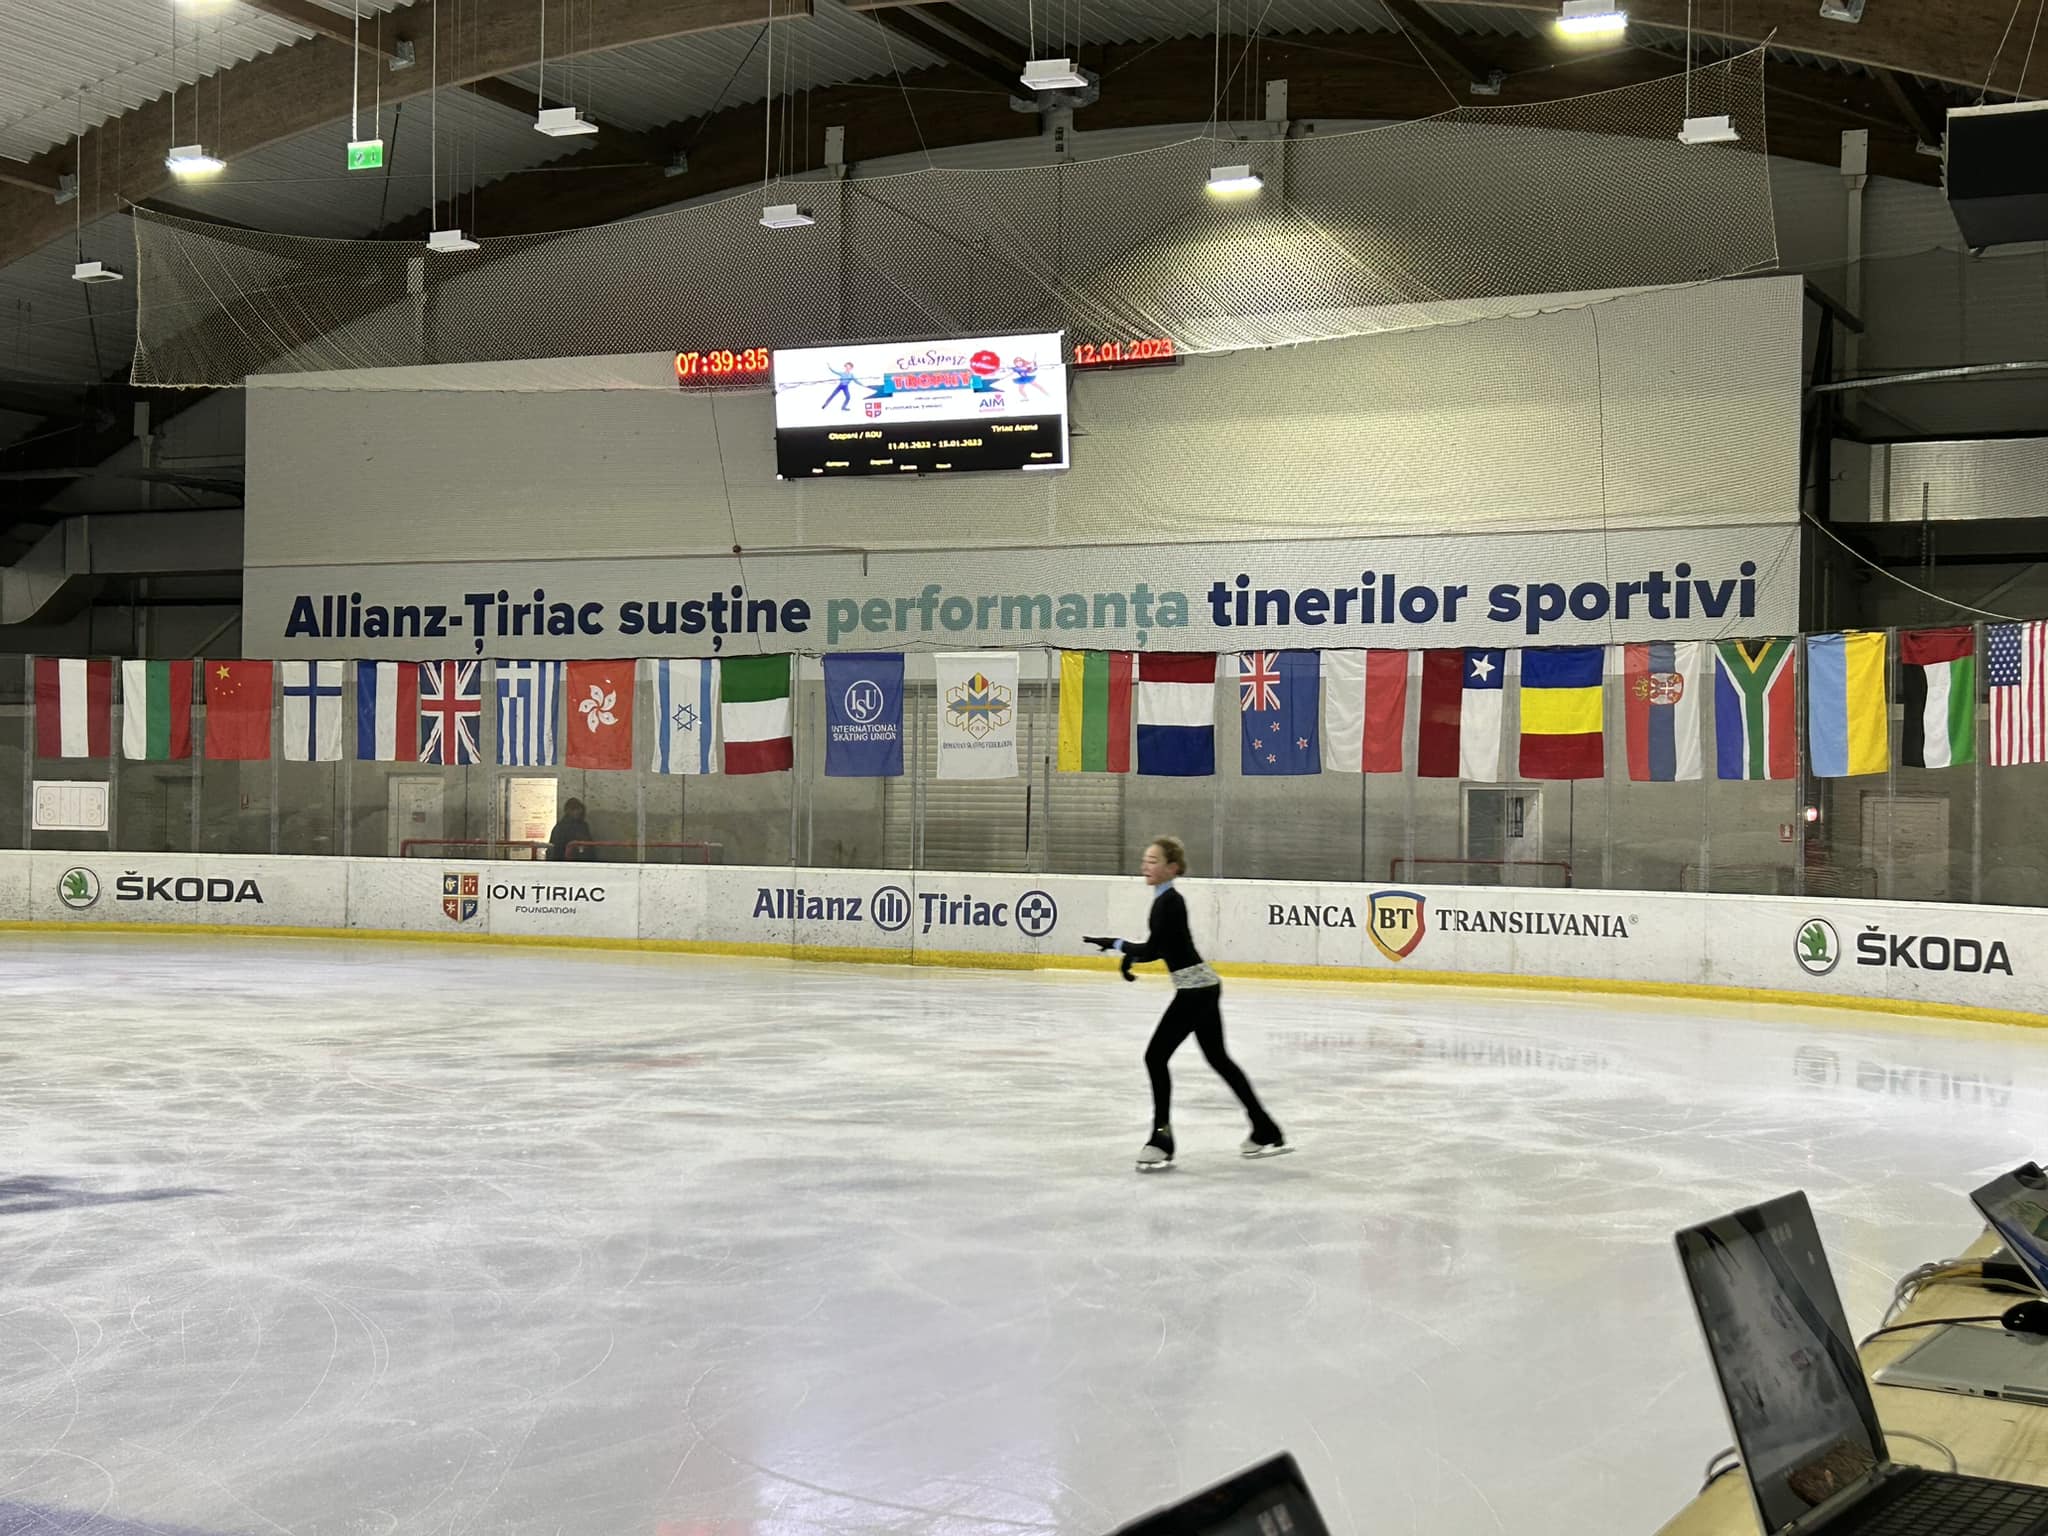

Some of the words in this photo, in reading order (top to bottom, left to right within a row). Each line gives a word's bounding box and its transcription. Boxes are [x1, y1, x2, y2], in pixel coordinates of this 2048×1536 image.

[676, 348, 769, 375] 07:39:35
[1075, 338, 1172, 363] 12.01.2023
[893, 372, 971, 389] TROPHY
[979, 398, 1005, 408] AIM
[284, 588, 605, 654] Allianz-Țiriac
[618, 586, 811, 652] susține
[827, 583, 1190, 646] performanța
[1208, 570, 1469, 626] tinerilor
[1486, 561, 1757, 634] sportivi
[831, 724, 897, 733] INTERNATIONAL
[833, 733, 868, 741] SKATING
[870, 732, 896, 741] UNION
[115, 869, 264, 903] ŠKODA
[486, 884, 525, 900] ION
[515, 906, 577, 915] FOUNDATION
[752, 887, 863, 921] Allianz
[1268, 904, 1357, 929] BANCA
[1379, 907, 1414, 930] BT
[1857, 925, 2014, 976] ŠKODA
